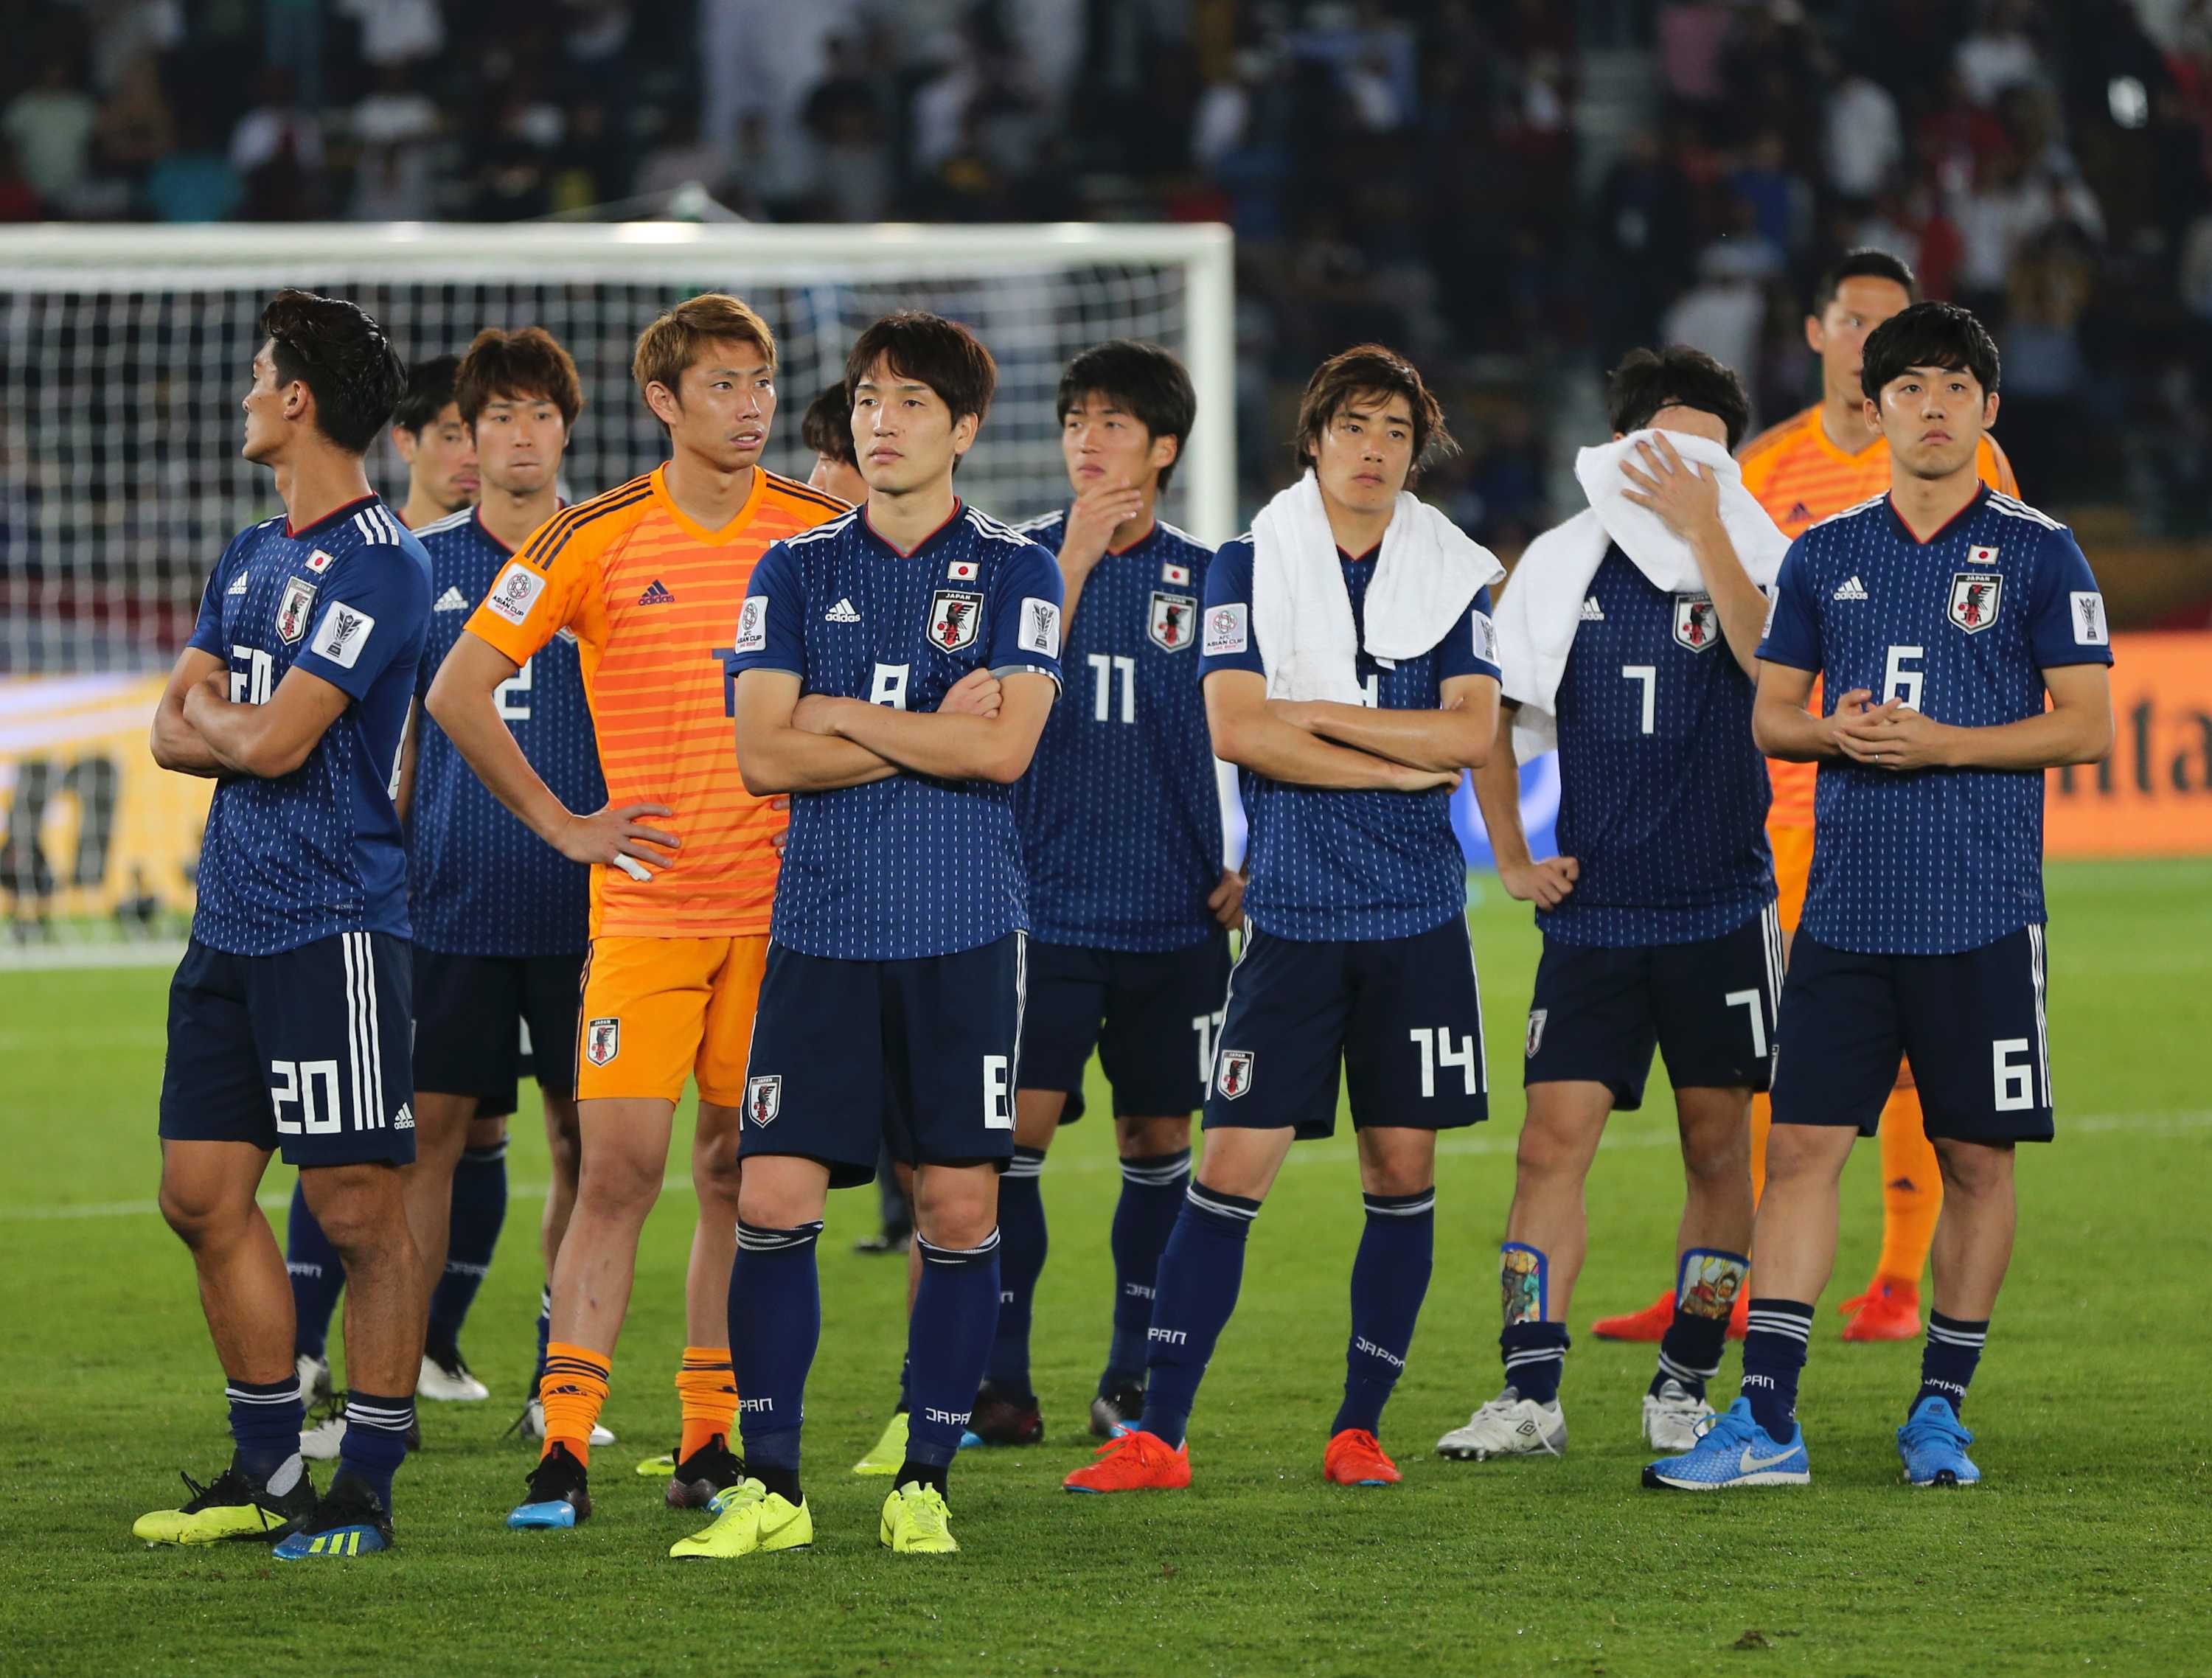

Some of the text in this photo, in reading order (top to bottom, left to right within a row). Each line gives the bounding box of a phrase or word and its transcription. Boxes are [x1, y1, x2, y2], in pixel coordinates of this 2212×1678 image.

[638, 595, 675, 606] adidas
[825, 613, 860, 622] adidas
[1833, 591, 1868, 600] adidas
[870, 662, 909, 711] 8
[1088, 653, 1135, 724] 11
[1622, 666, 1656, 734] 7
[1882, 645, 1924, 713] 6
[1725, 989, 1767, 1058] 7
[1411, 1027, 1476, 1097] 14
[1993, 1038, 2034, 1111] 6
[271, 1059, 342, 1134] 20
[394, 1119, 415, 1129] adida
[925, 1407, 972, 1425] JAPA
